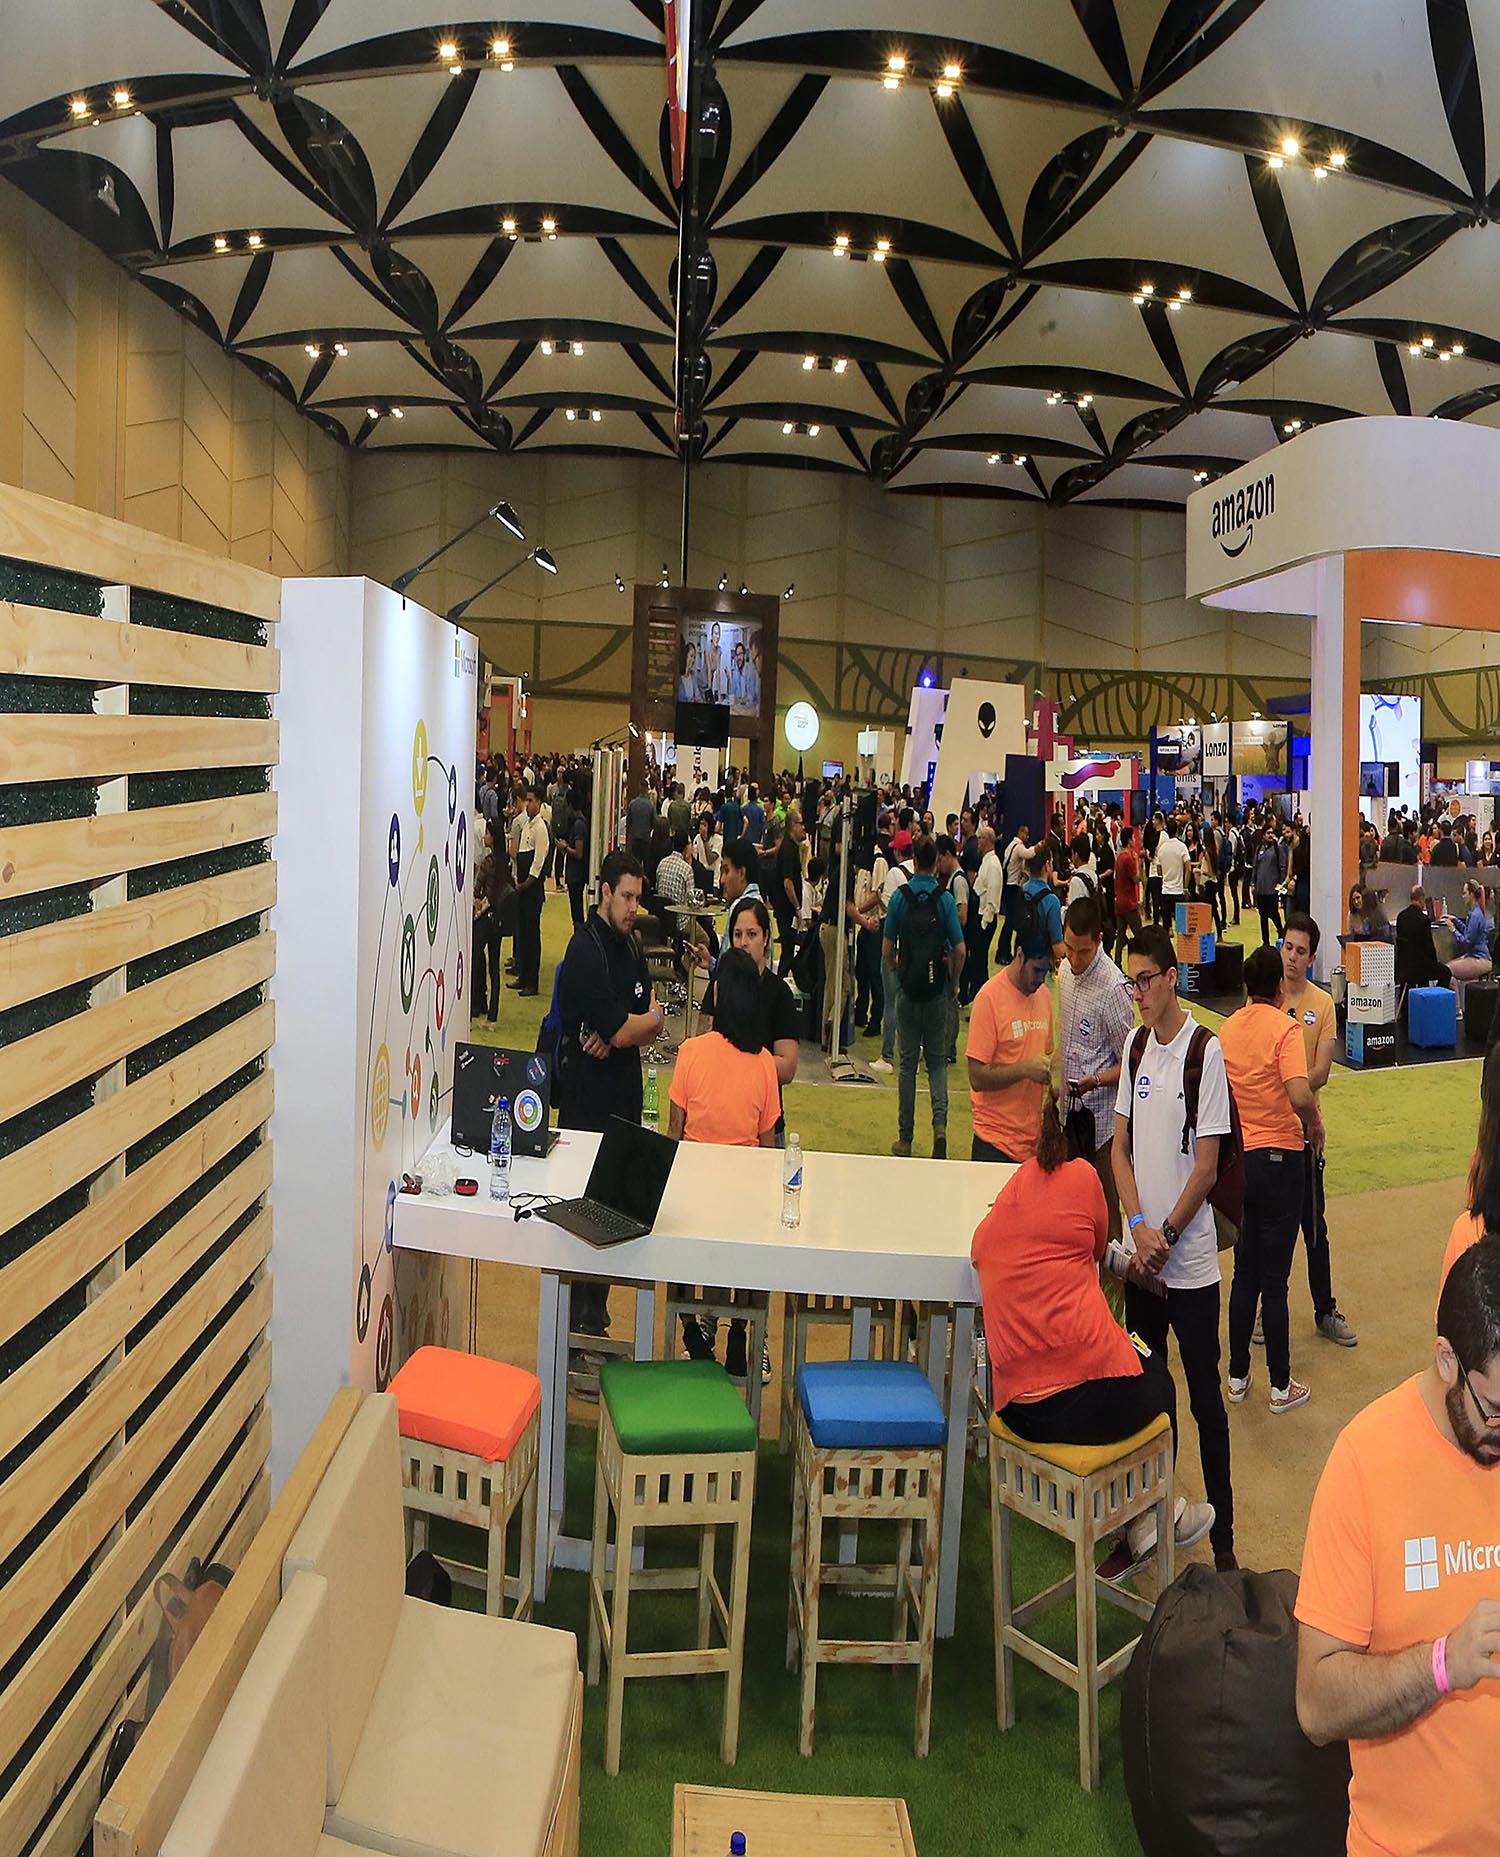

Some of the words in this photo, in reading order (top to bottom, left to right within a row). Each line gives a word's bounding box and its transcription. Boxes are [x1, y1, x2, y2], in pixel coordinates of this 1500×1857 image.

[1212, 474, 1275, 538] amazon
[1350, 996, 1382, 1008] amazon
[1366, 1035, 1394, 1047] amazon
